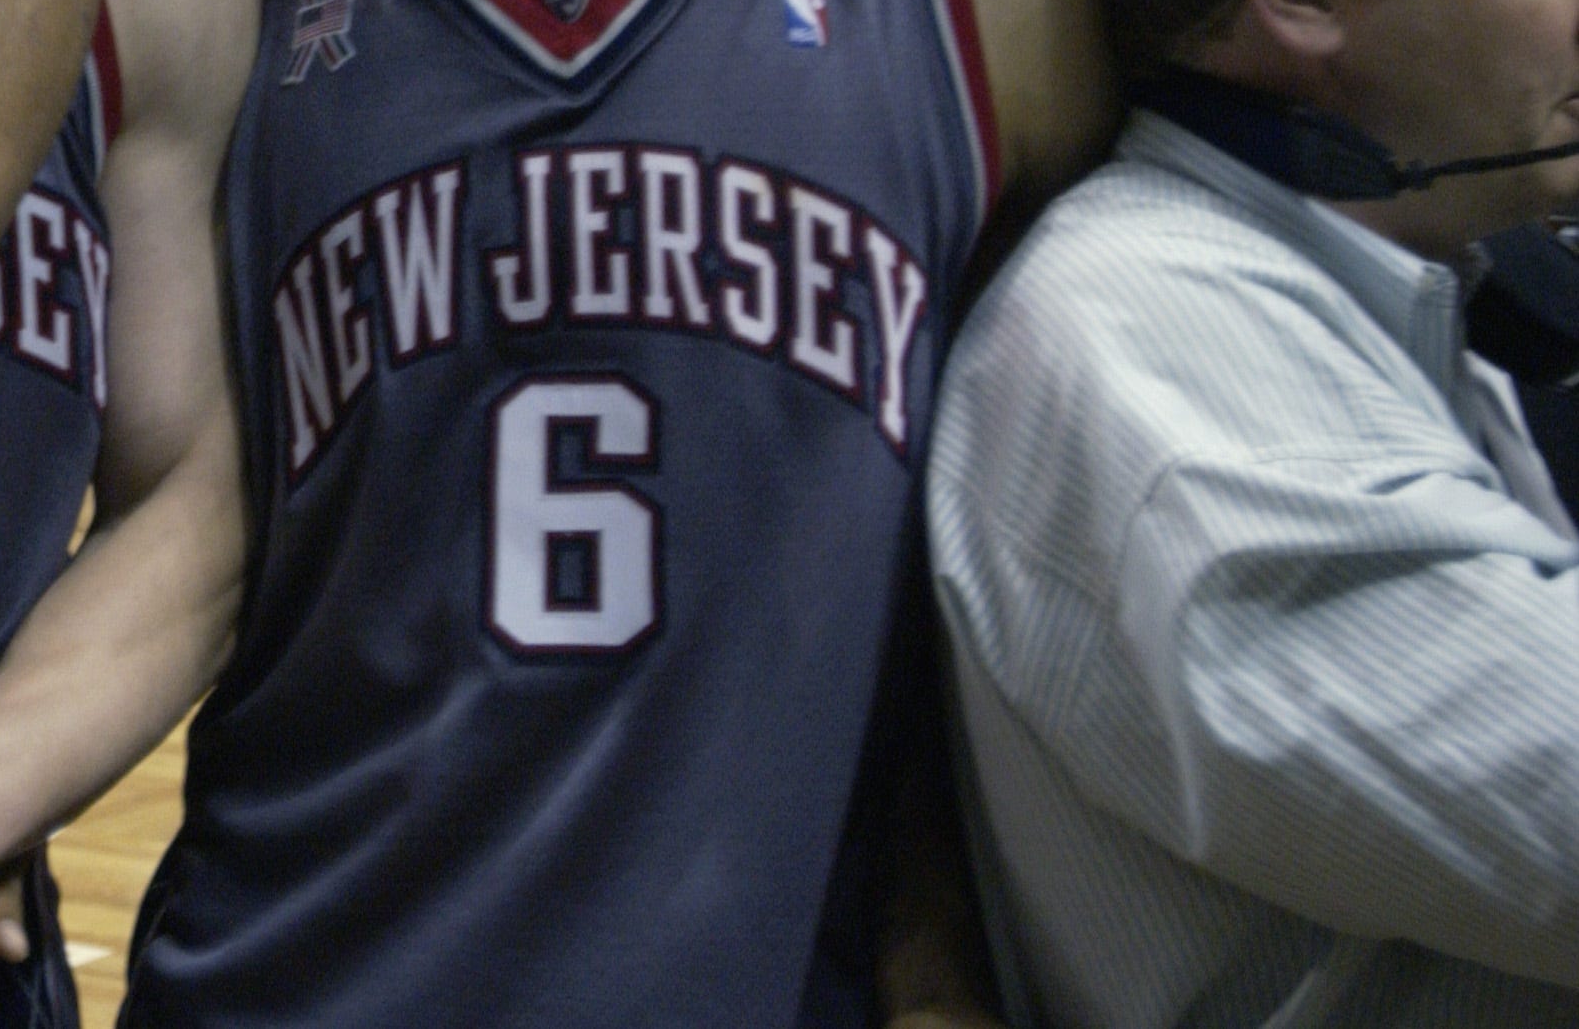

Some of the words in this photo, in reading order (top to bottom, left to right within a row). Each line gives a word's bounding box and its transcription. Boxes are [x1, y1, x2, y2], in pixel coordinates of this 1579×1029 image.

[272, 161, 463, 474] NEW
[491, 147, 927, 449] JERSEY
[489, 375, 661, 653] 6
